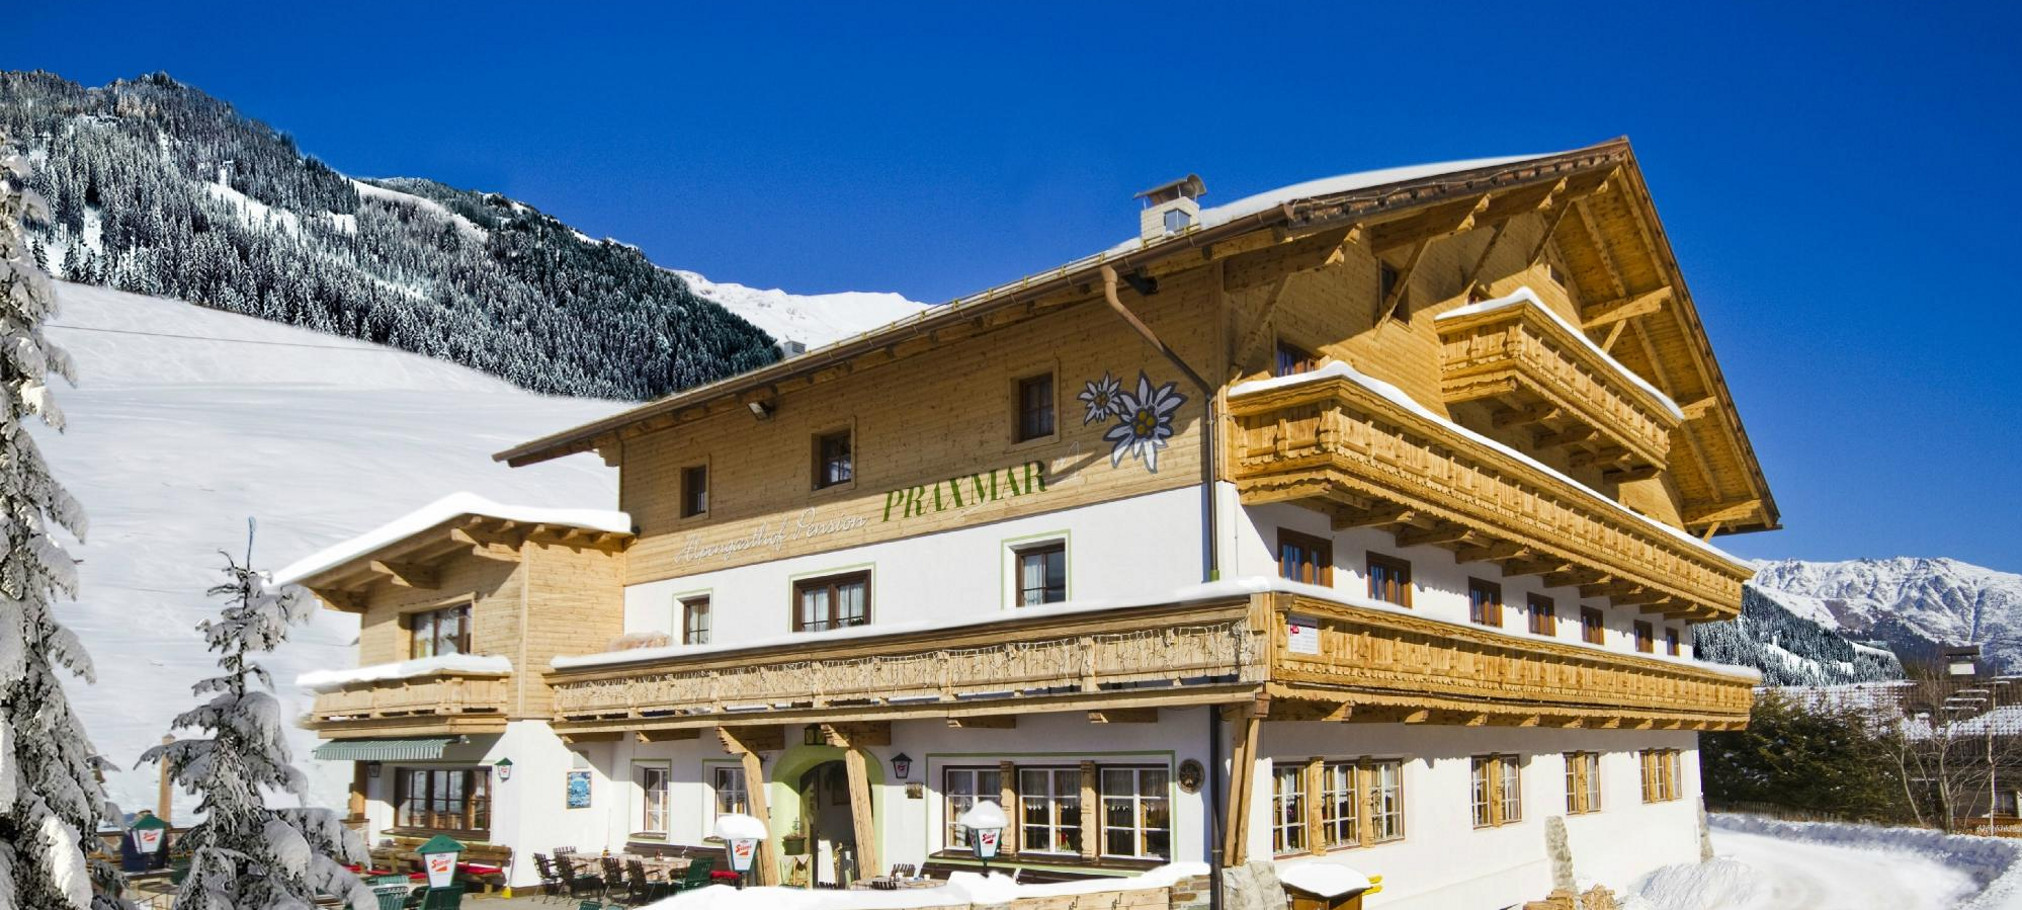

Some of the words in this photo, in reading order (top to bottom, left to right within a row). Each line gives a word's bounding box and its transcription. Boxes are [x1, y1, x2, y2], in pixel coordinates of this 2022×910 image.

[673, 517, 789, 565] Alpengasthof
[792, 506, 869, 540] Pension
[881, 459, 1047, 522] PRAXMAR
